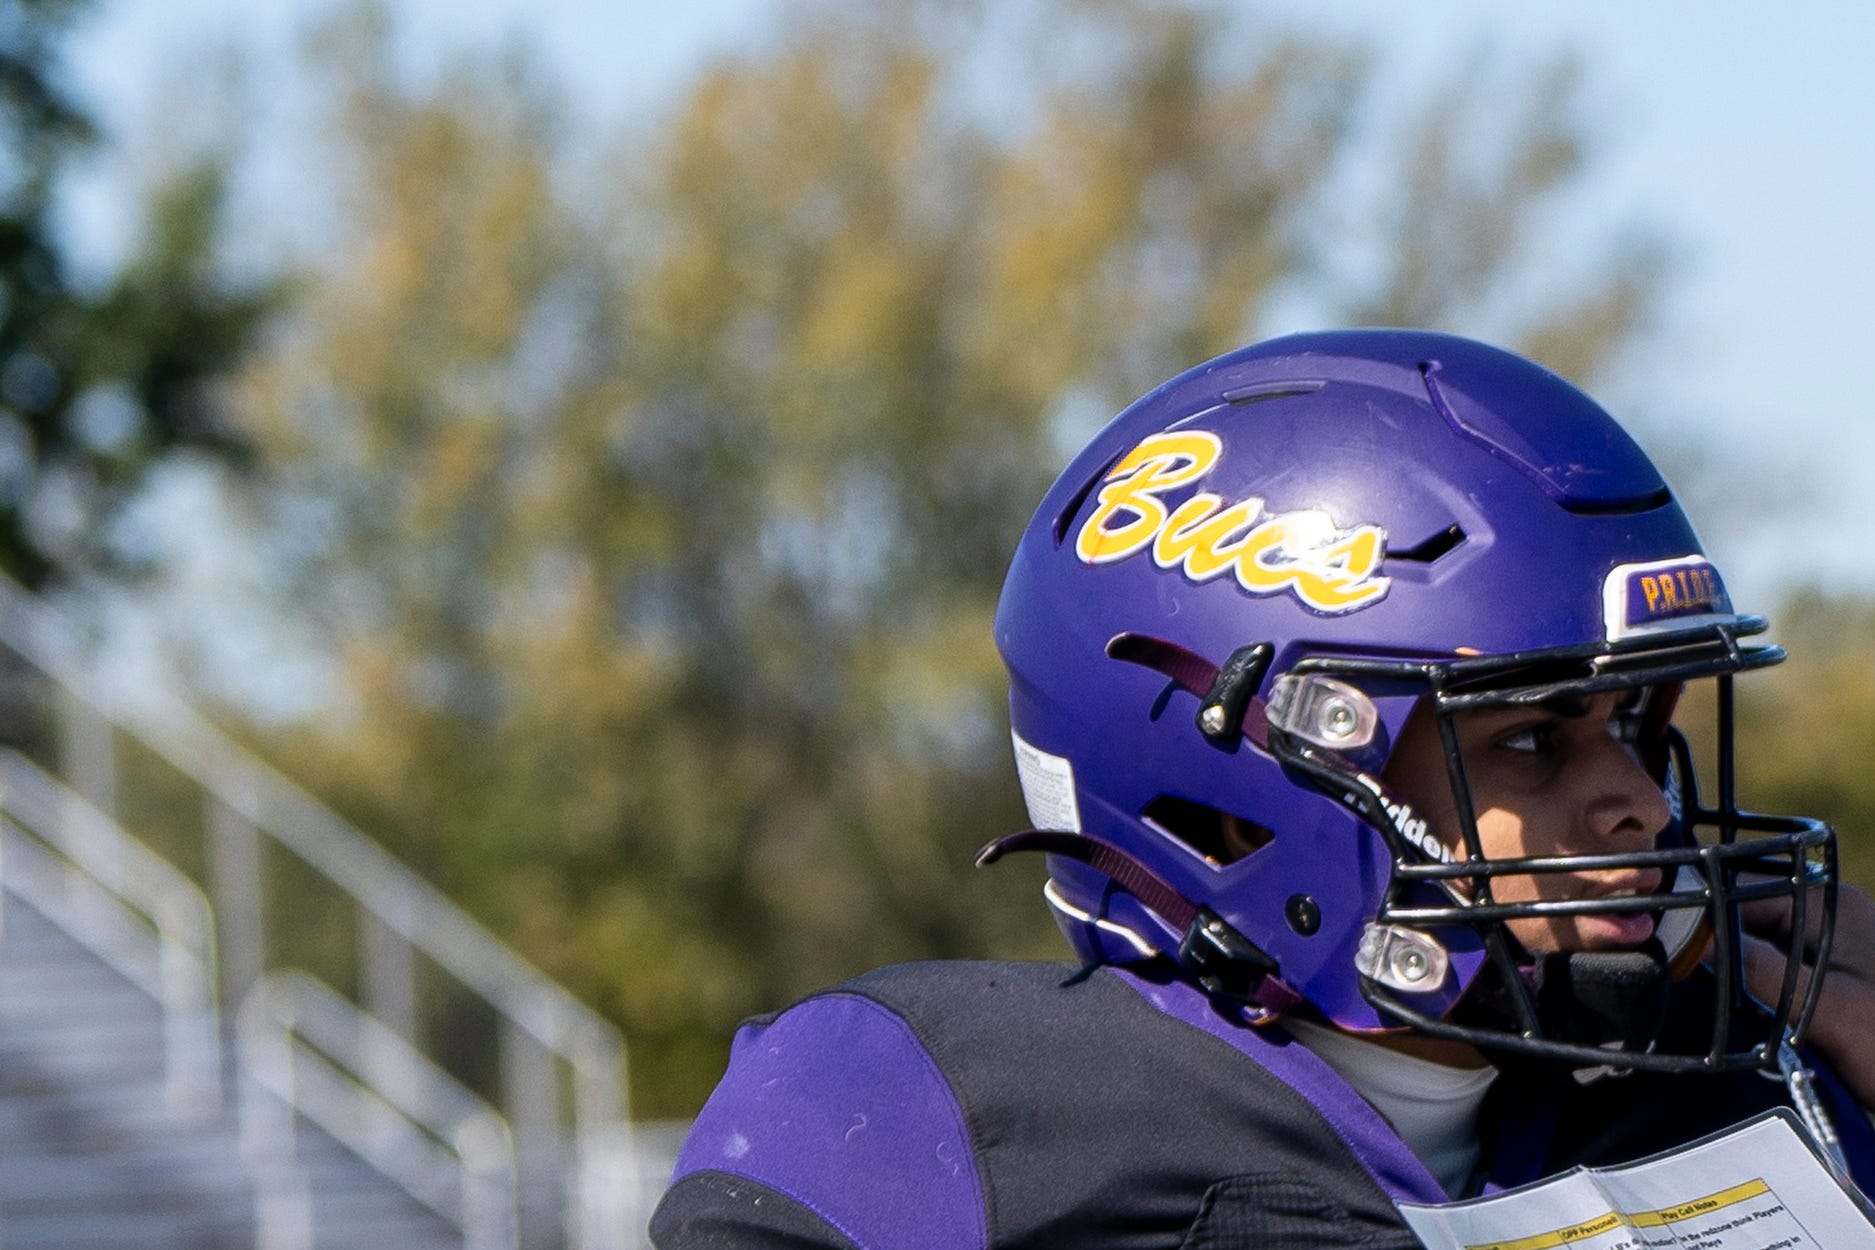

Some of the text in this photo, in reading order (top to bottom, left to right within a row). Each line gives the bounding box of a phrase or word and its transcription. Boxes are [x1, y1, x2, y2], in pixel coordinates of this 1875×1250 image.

[1075, 430, 1392, 617] Bucs
[1344, 773, 1456, 863] ddel
[1678, 1205, 1694, 1216] Call
[1732, 1215, 1753, 1227] think
